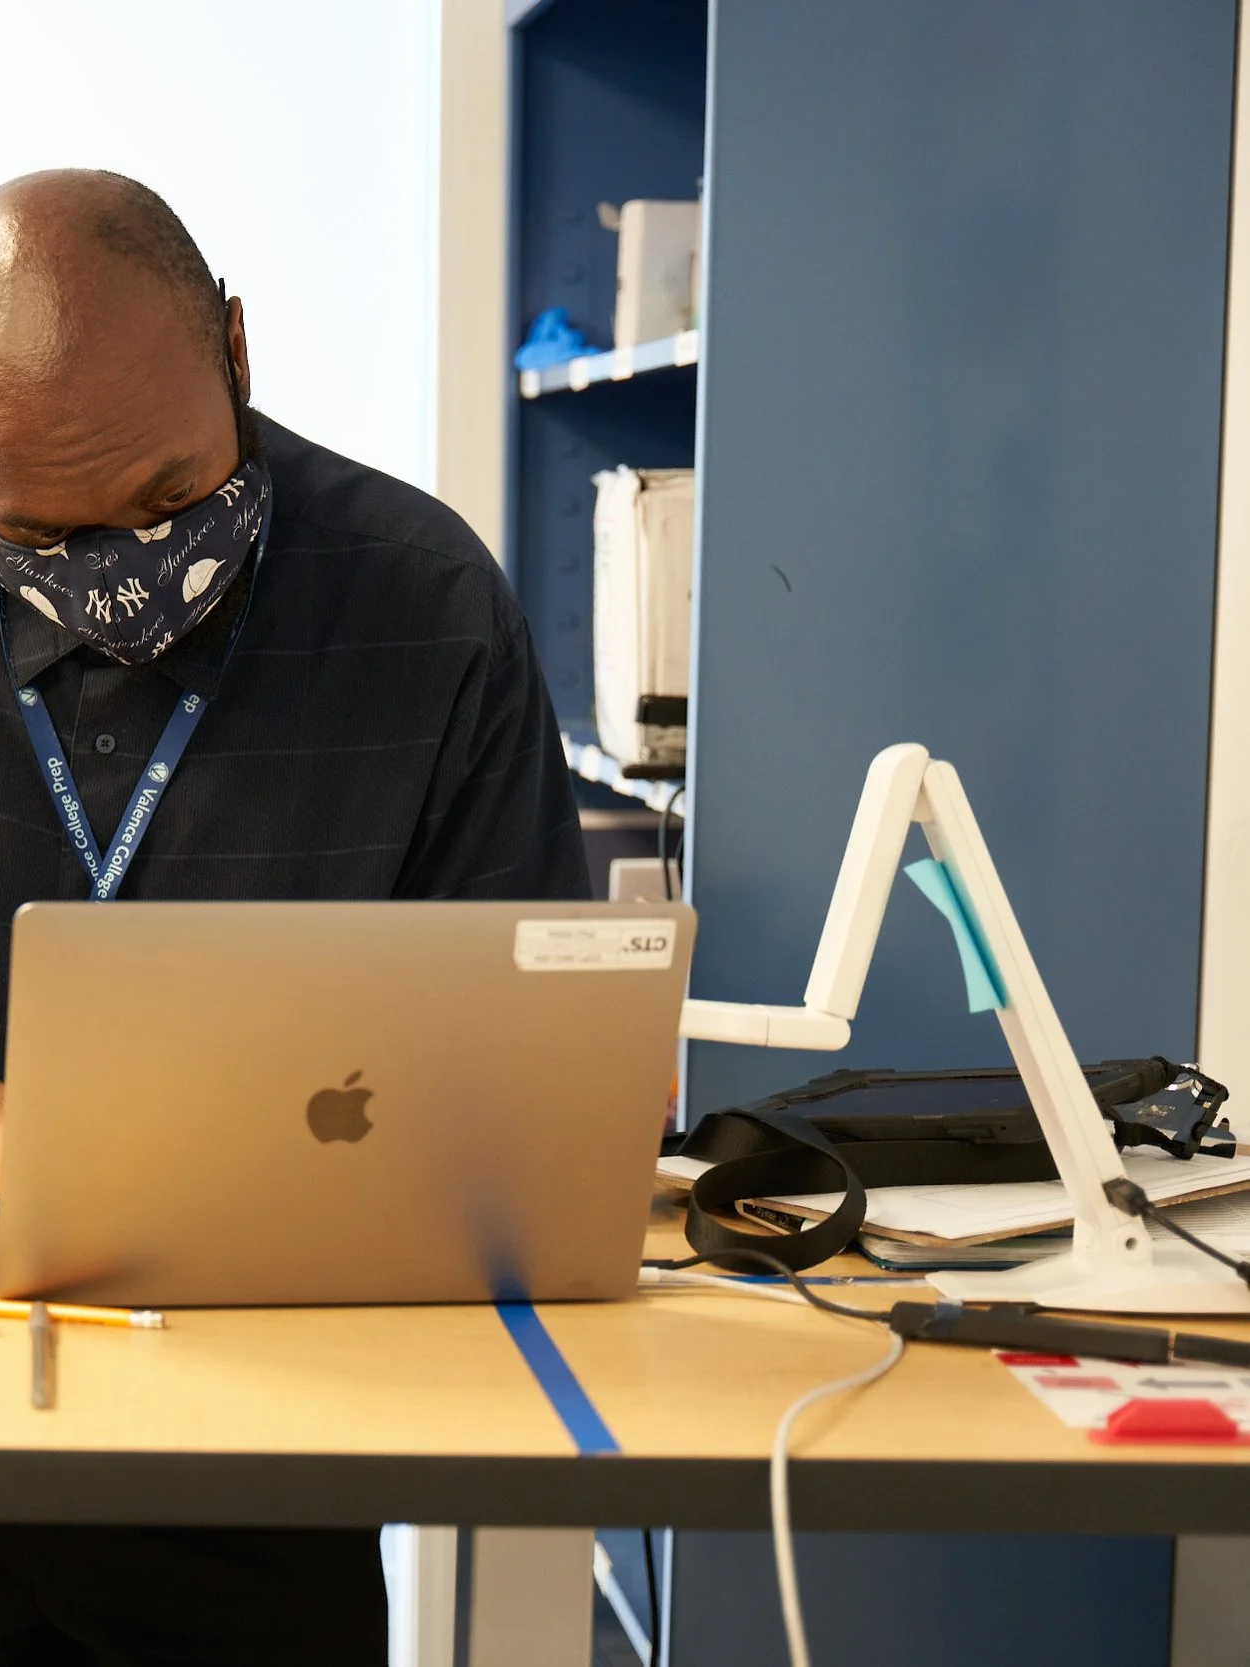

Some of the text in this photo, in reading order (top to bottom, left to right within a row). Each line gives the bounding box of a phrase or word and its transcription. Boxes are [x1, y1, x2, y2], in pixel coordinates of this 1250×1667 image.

[6, 553, 74, 598] Yankees
[157, 516, 216, 587] Yankees
[116, 577, 150, 617] NY
[183, 693, 200, 714] ep
[47, 757, 89, 850] College Prep
[96, 788, 159, 900] Valence College
